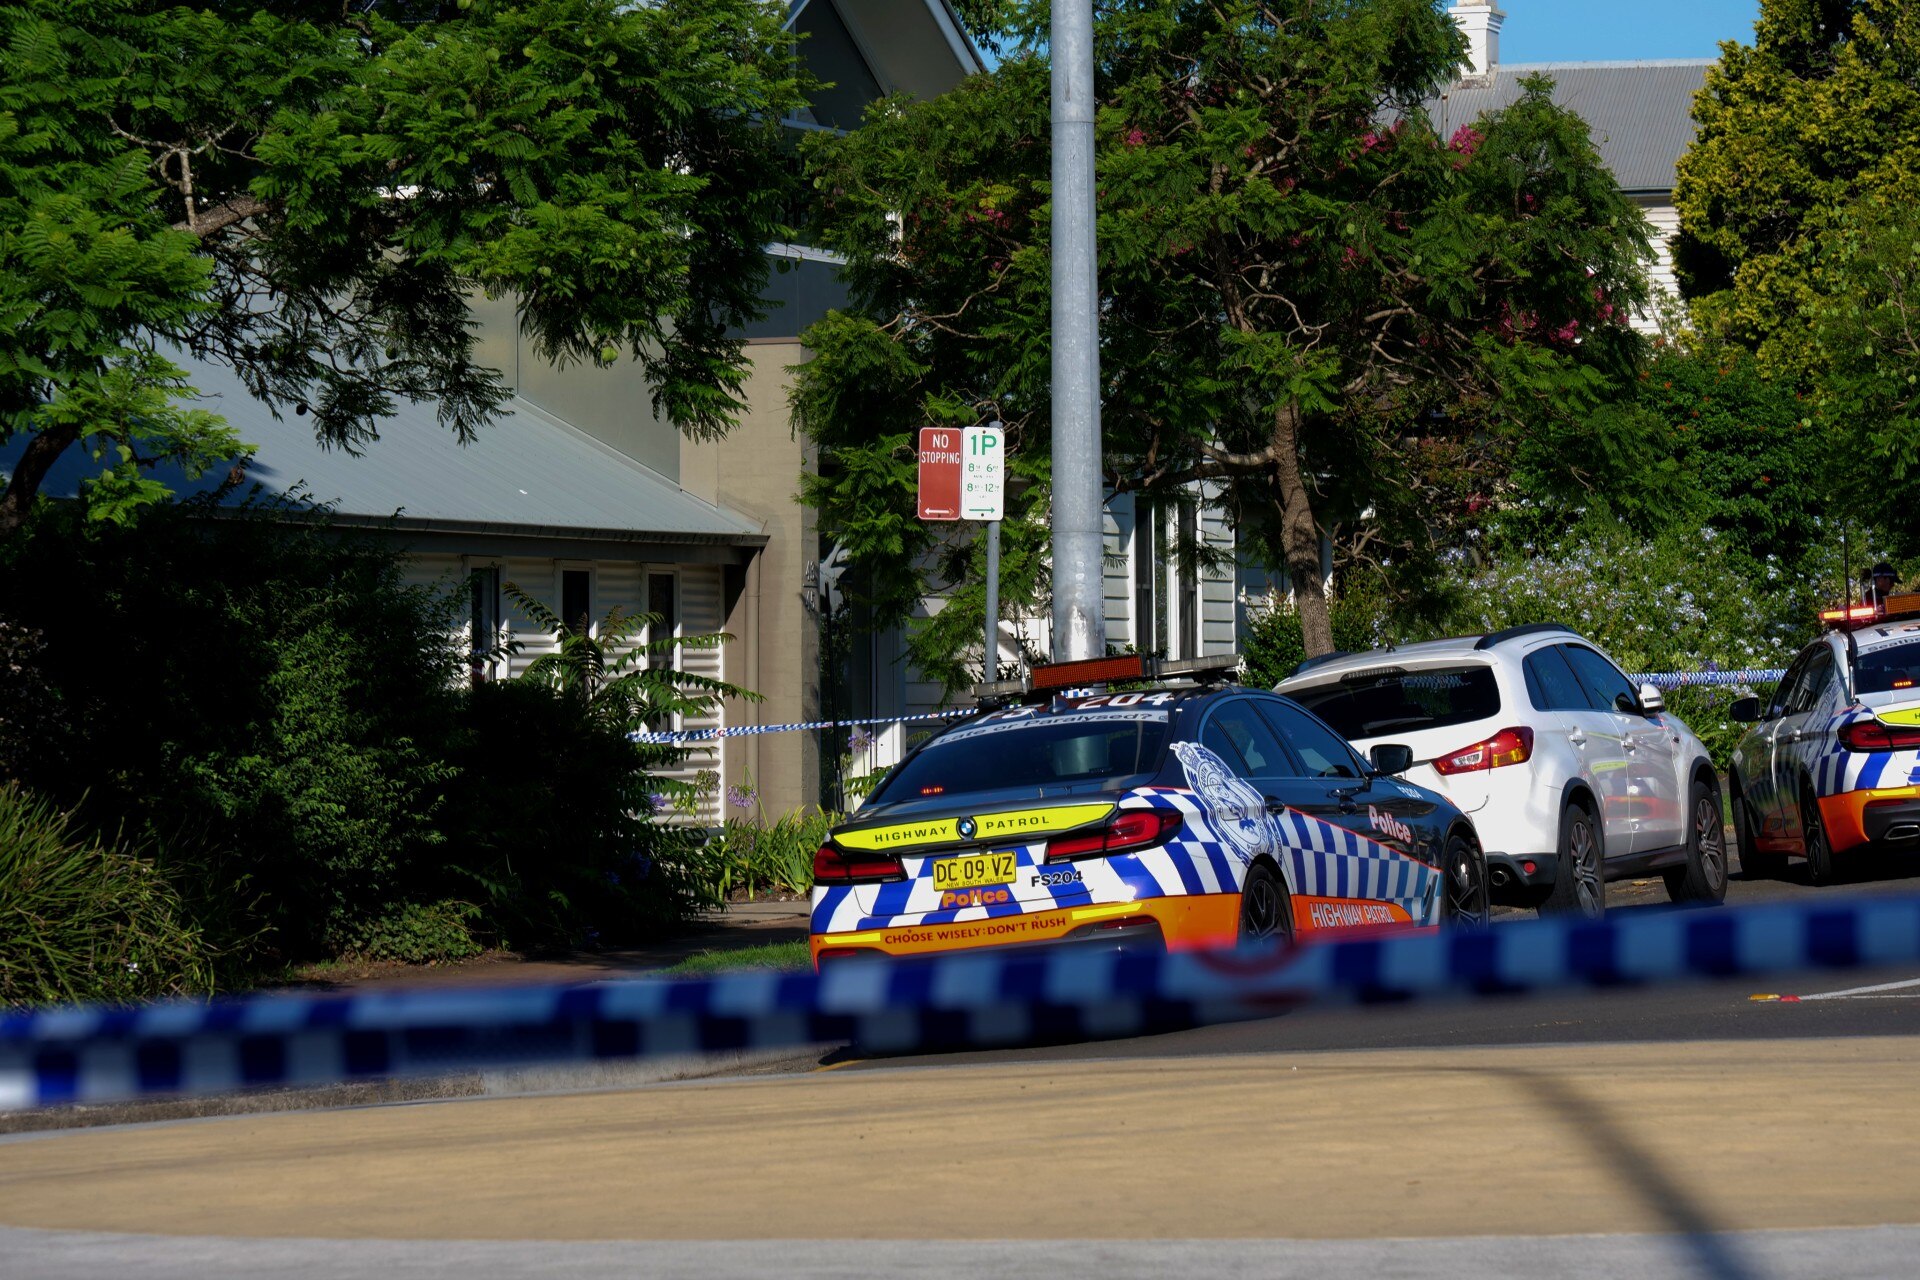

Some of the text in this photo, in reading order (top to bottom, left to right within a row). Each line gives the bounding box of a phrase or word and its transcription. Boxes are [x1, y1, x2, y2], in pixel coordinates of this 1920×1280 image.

[932, 434, 949, 449] NO
[970, 434, 998, 456] 1P
[921, 451, 960, 465] STOPPING
[1076, 692, 1175, 710] 204
[940, 712, 1153, 744] Late or Paralysed?
[875, 815, 1050, 843] HIGHWAY PATROL
[1368, 804, 1412, 844] Police
[962, 879, 982, 887] SOUTH
[984, 876, 1004, 885] WALES
[1031, 870, 1083, 888] FS204
[942, 888, 1009, 908] Police
[1309, 901, 1396, 928] HIGHWAY PATROL
[884, 931, 933, 945] CHOOSE
[1031, 917, 1066, 930] RUSH
